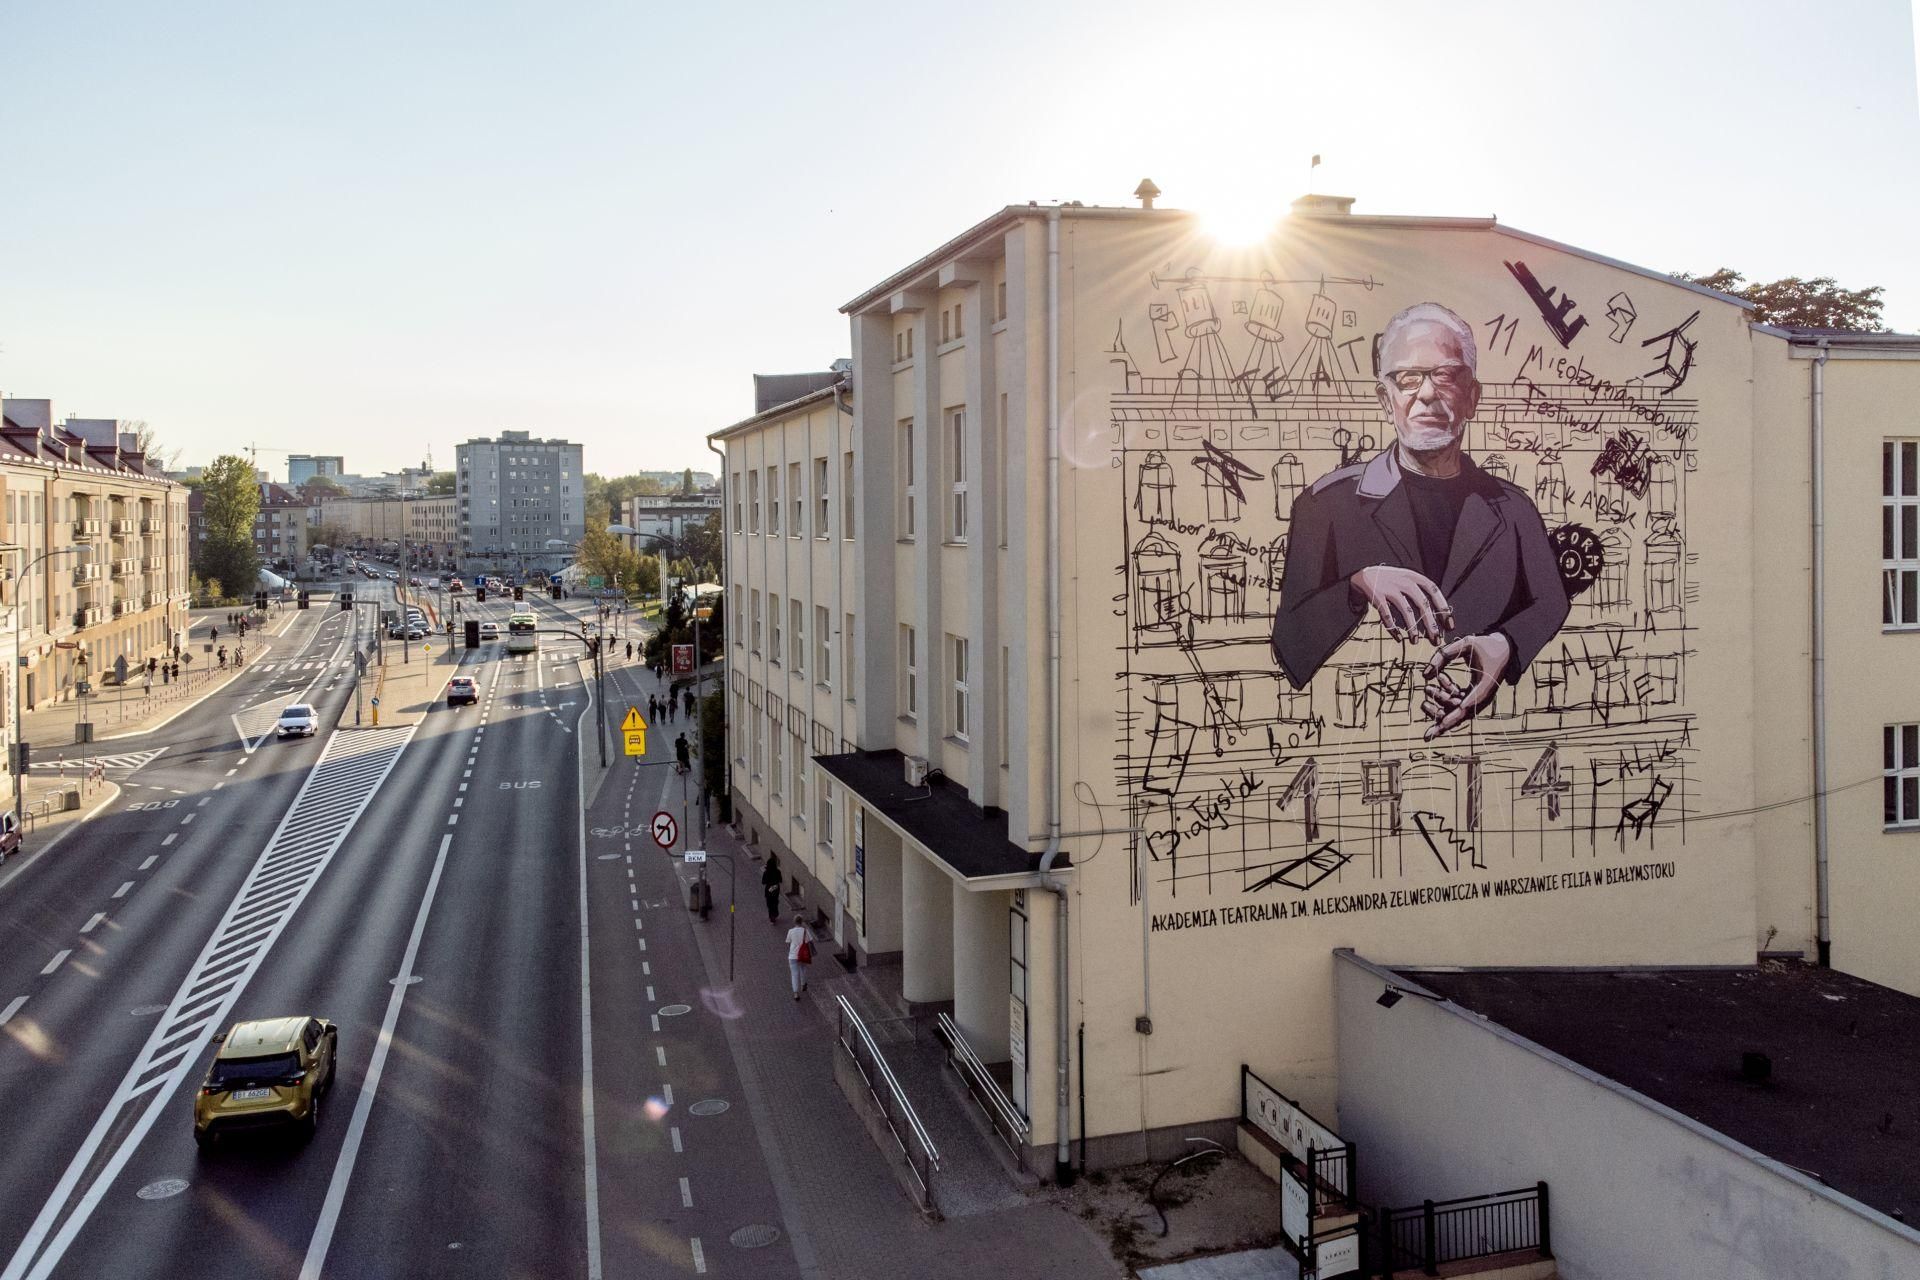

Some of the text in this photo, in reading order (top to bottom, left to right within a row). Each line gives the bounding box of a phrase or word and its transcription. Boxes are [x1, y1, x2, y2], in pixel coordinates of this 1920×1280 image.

[498, 780, 542, 790] BUS
[125, 799, 181, 812] BUS
[1151, 861, 1675, 932] AKADEMIA TEATRALNA IM. ALEKSANDRA ZELWEROWICZA W WARSZAWIE FILIA W BIAŁYMSTOKU
